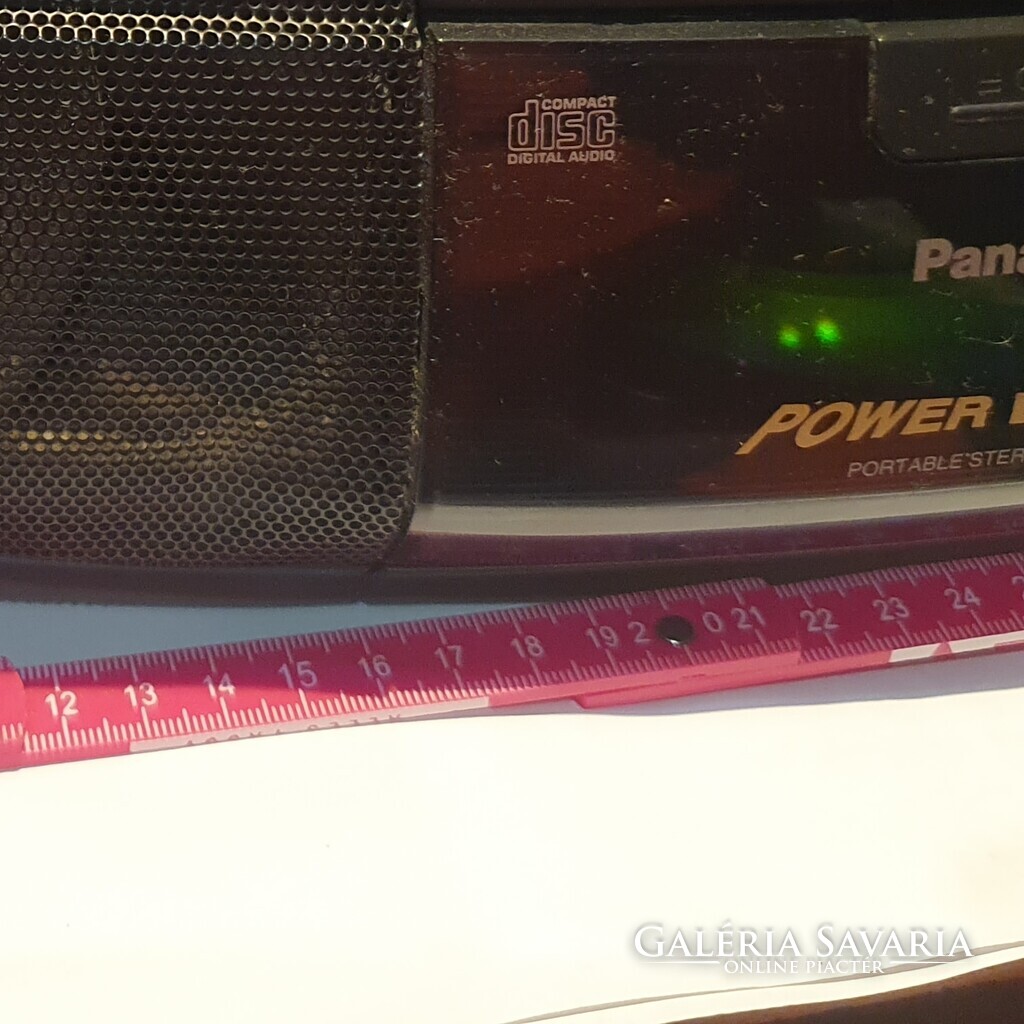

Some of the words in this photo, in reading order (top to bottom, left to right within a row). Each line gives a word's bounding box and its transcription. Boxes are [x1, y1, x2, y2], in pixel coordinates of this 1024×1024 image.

[541, 96, 617, 110] COMPACT
[507, 152, 565, 165] DIGITAL
[568, 150, 616, 163] AUDIO
[913, 237, 1024, 282] Pan
[735, 395, 993, 455] POWER
[847, 453, 963, 477] PORTABLE
[44, 692, 79, 715] 12
[124, 684, 158, 707] 13
[203, 675, 236, 698] 14
[278, 663, 317, 688] 15
[357, 654, 392, 678] 16
[434, 645, 464, 669] 17
[510, 635, 545, 659] 18
[586, 626, 621, 650] 19
[733, 607, 765, 629] 21
[800, 607, 837, 632] 22
[874, 597, 909, 621] 23
[943, 587, 981, 609] 24
